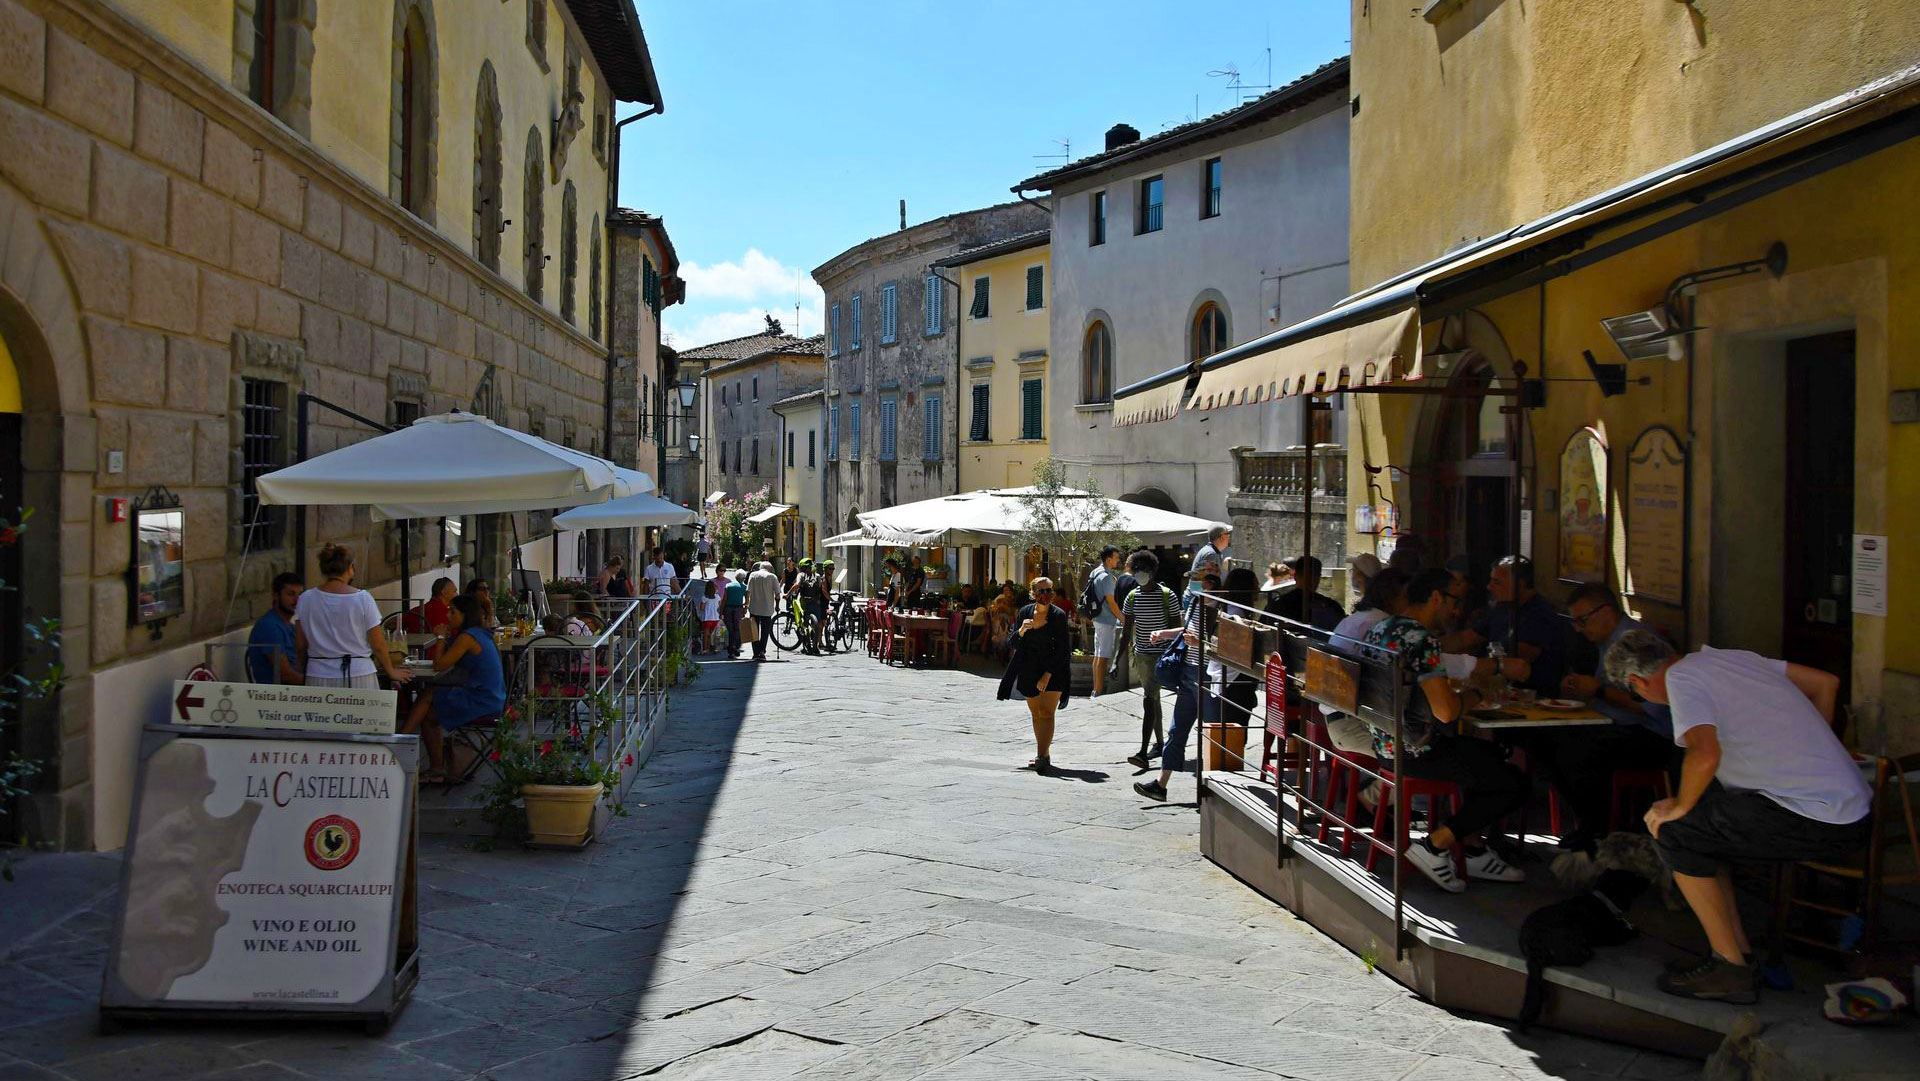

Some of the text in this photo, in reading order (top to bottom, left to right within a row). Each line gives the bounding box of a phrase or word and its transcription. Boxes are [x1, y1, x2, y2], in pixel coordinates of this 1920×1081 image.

[247, 689, 277, 702] Visita
[279, 690, 290, 702] la
[291, 692, 323, 704] nostra
[325, 693, 366, 707] Cantina
[258, 709, 282, 721] Visit
[284, 713, 302, 723] our
[304, 712, 331, 724] Wine
[333, 713, 364, 725] Cellar
[249, 752, 397, 766] ANTICA FATTORIA
[246, 770, 390, 807] LA CASTELLINA
[217, 883, 393, 897] ENOTECA SQUARCIALUPI
[252, 919, 356, 933] VINO E OLIO
[243, 939, 361, 953] WINE AND OIL
